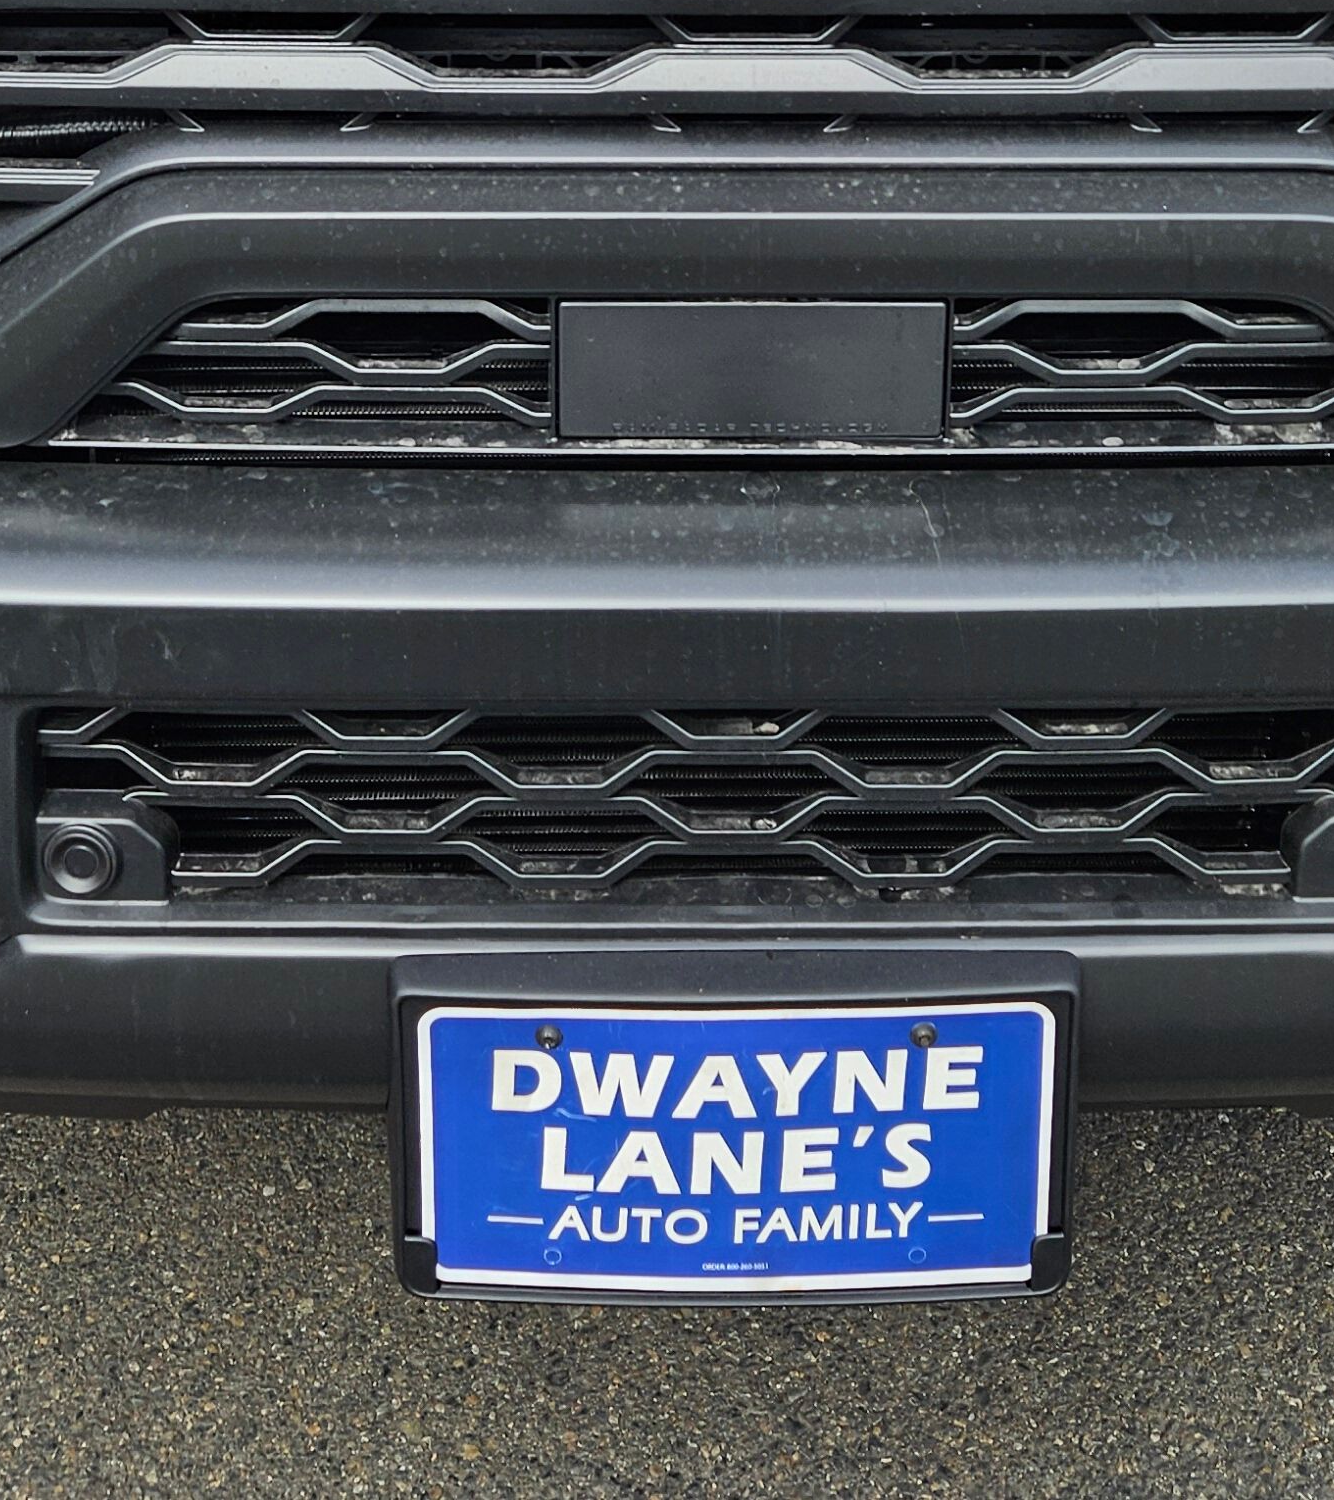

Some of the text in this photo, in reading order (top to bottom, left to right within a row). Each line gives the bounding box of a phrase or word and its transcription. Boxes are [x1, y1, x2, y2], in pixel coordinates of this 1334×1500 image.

[491, 1045, 984, 1119] DWAYNE
[540, 1123, 932, 1195] LANE'S
[548, 1201, 924, 1244] AUTO FAMILY
